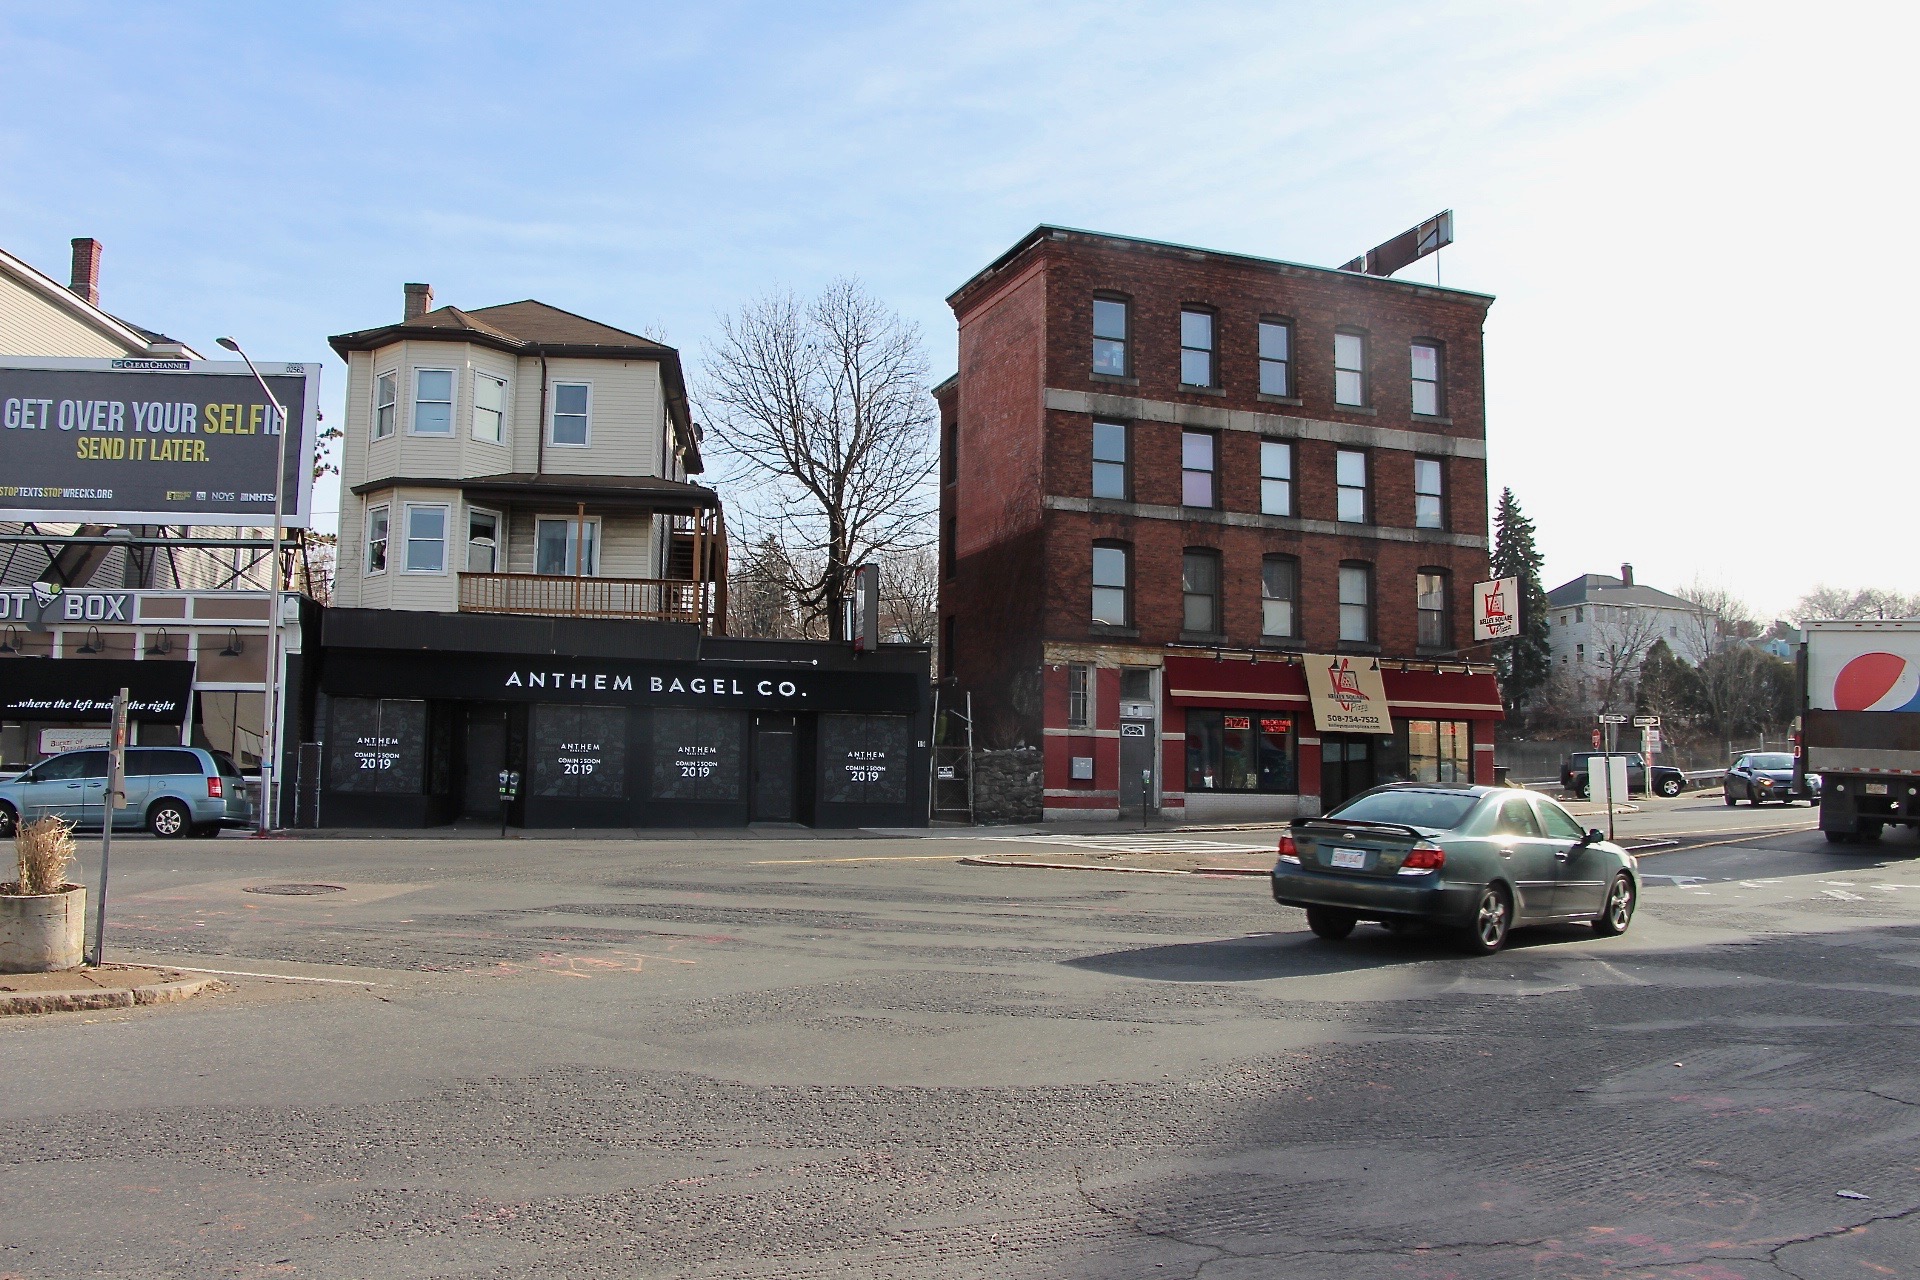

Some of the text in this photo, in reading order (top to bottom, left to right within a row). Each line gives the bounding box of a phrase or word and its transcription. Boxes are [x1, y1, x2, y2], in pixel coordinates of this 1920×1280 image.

[4, 398, 53, 430] GET
[58, 400, 125, 432] OVER
[132, 402, 197, 433] YOUR
[77, 437, 210, 462] SEND IT LATER.
[211, 492, 235, 501] NOYS
[248, 493, 277, 502] NHTS
[64, 595, 127, 620] BOX
[505, 671, 807, 697] ANTHEM BAGEL CO.
[53, 699, 72, 709] the
[73, 699, 93, 712] left
[94, 701, 115, 709] mee
[127, 700, 146, 710] the
[147, 701, 176, 713] right
[1224, 717, 1249, 728] PIZZA
[356, 737, 399, 745] ANTHEM
[560, 743, 600, 751] ANTHEM
[360, 758, 391, 770] 2019
[563, 763, 593, 775] 2019
[681, 766, 710, 778] 2019
[851, 771, 879, 782] 2019
